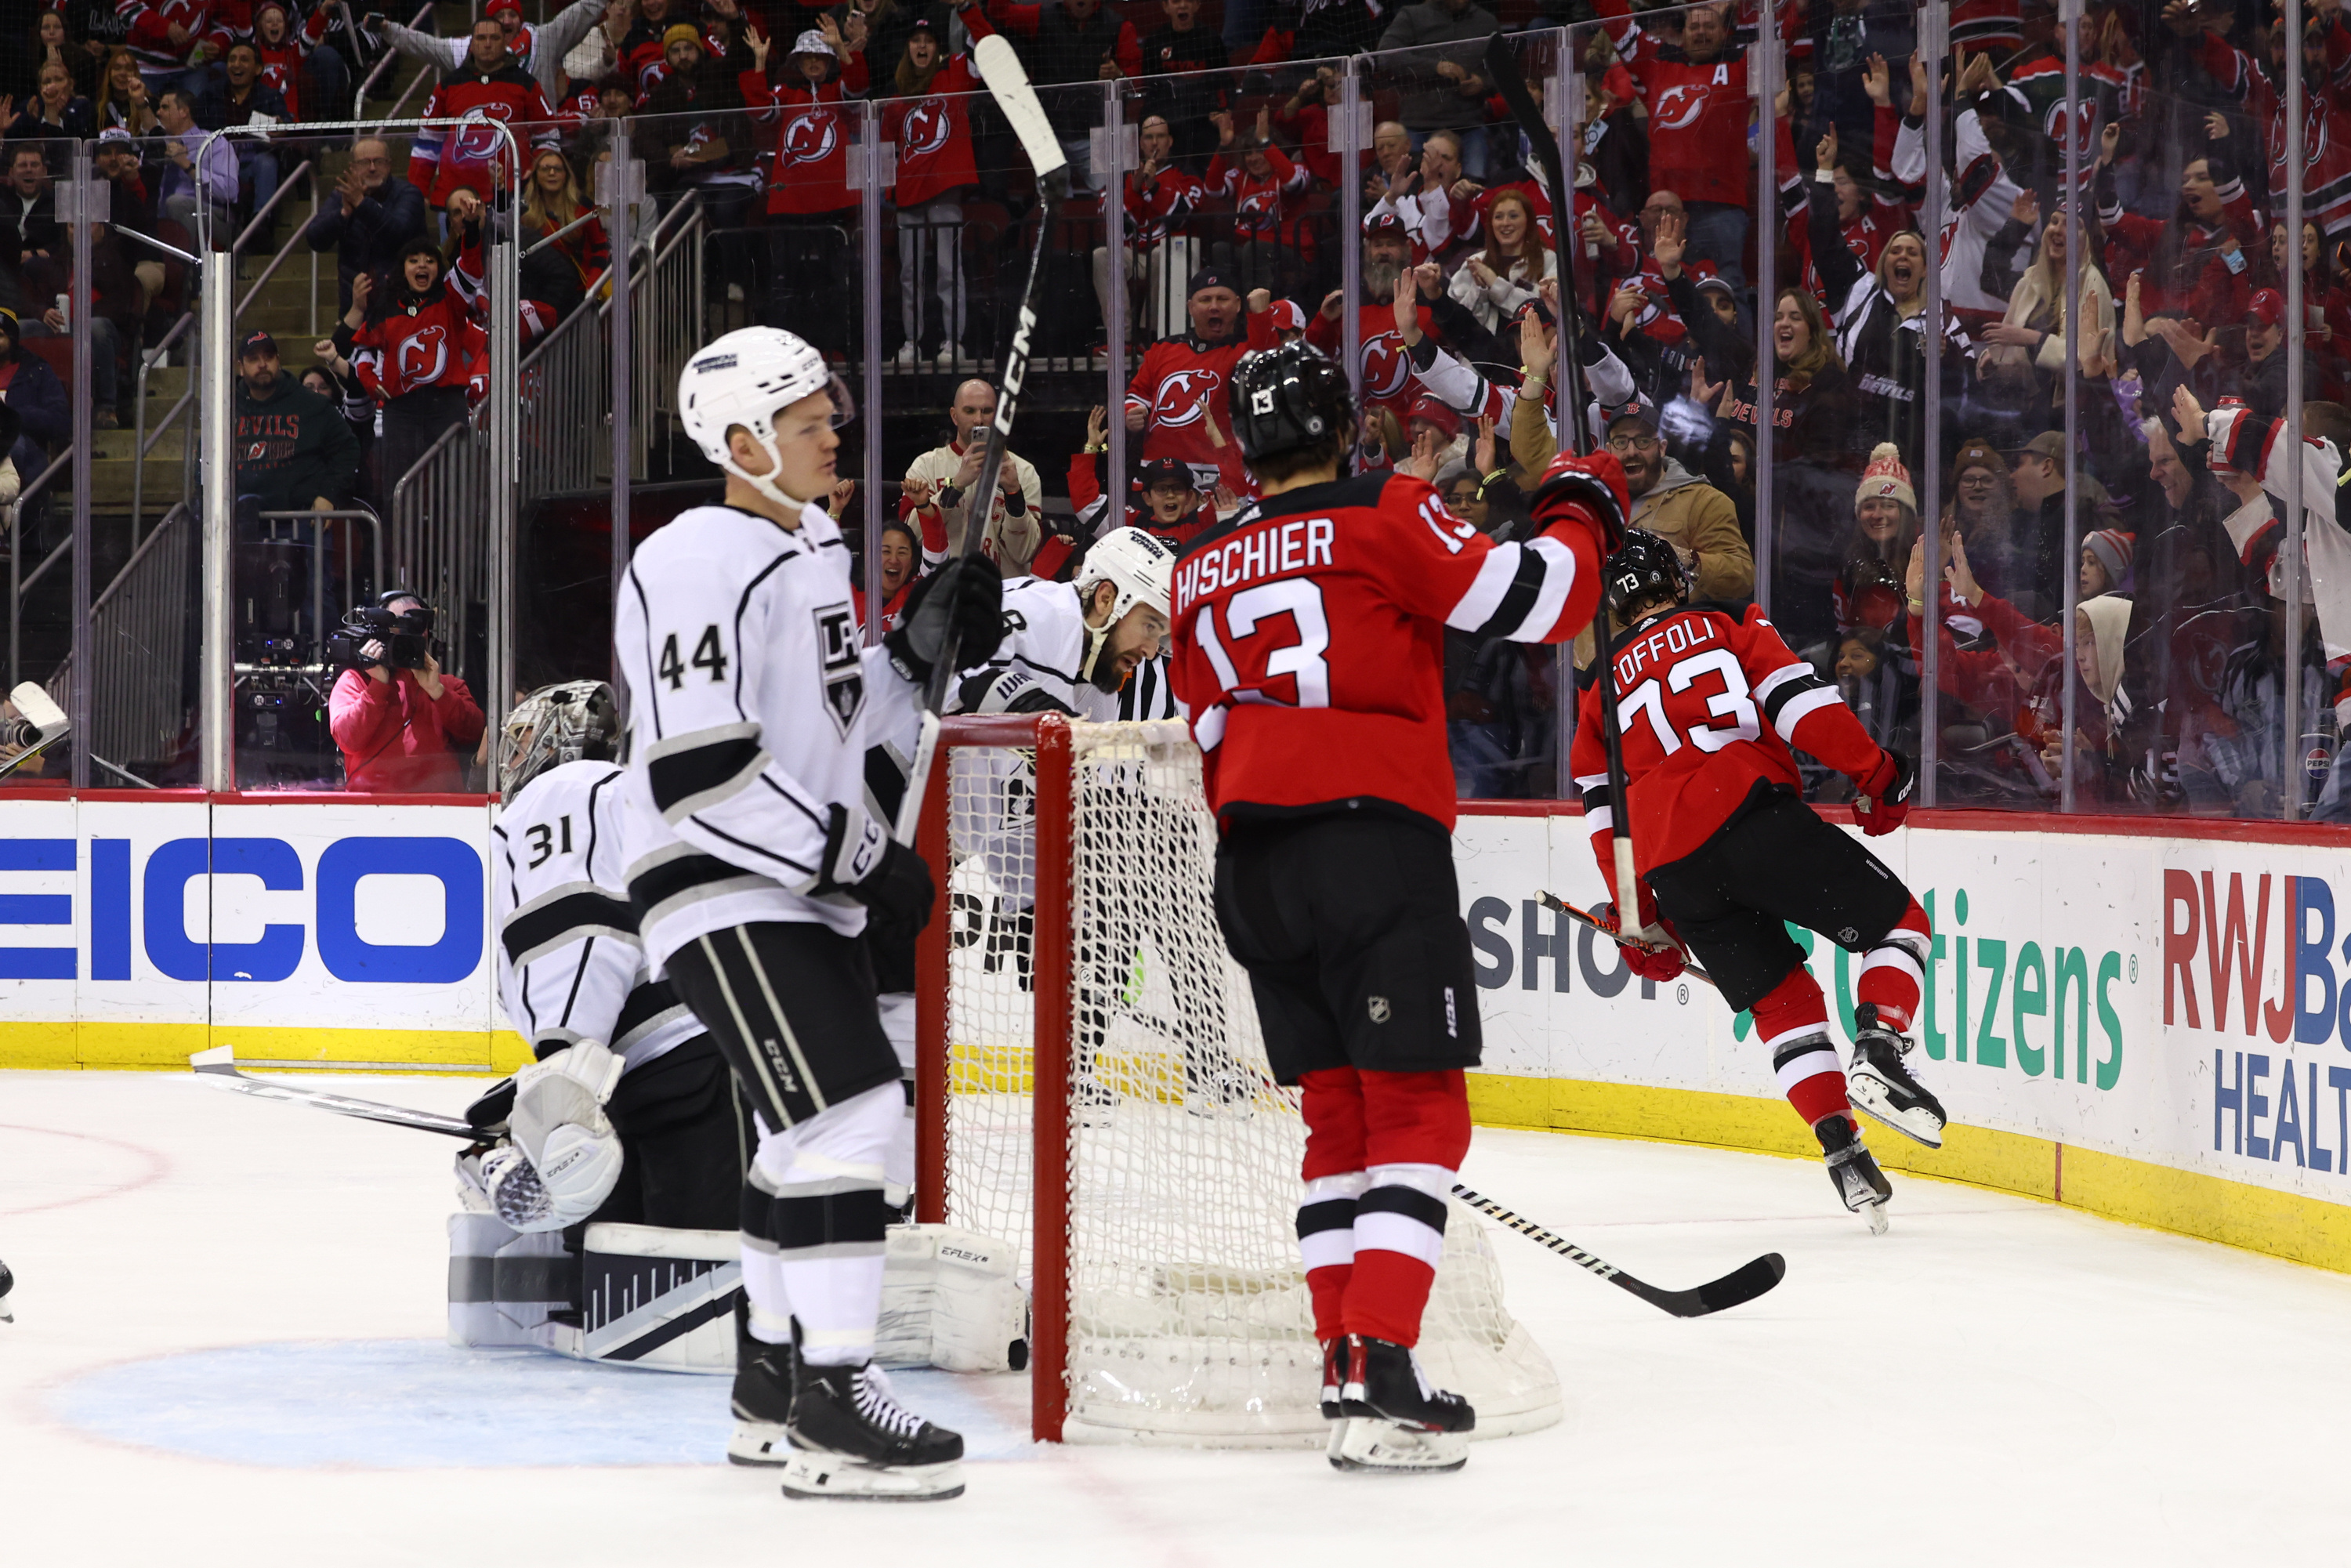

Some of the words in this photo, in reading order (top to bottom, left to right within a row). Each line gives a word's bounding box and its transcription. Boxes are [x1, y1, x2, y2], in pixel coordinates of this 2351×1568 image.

[1712, 63, 1729, 85] A
[994, 305, 1037, 436] CCM
[235, 414, 299, 440] EVILS
[1251, 389, 1275, 416] 13
[1731, 398, 1794, 428] DEVLS
[1417, 493, 1478, 555] 13
[1176, 517, 1335, 615] HISCHIER
[1616, 573, 1640, 594] 73
[658, 625, 727, 690] 44
[1194, 577, 1331, 744] 13
[1617, 648, 1762, 756] 73
[525, 815, 573, 870] 31
[1467, 896, 1657, 1001] SHO
[763, 1038, 799, 1093] CCM
